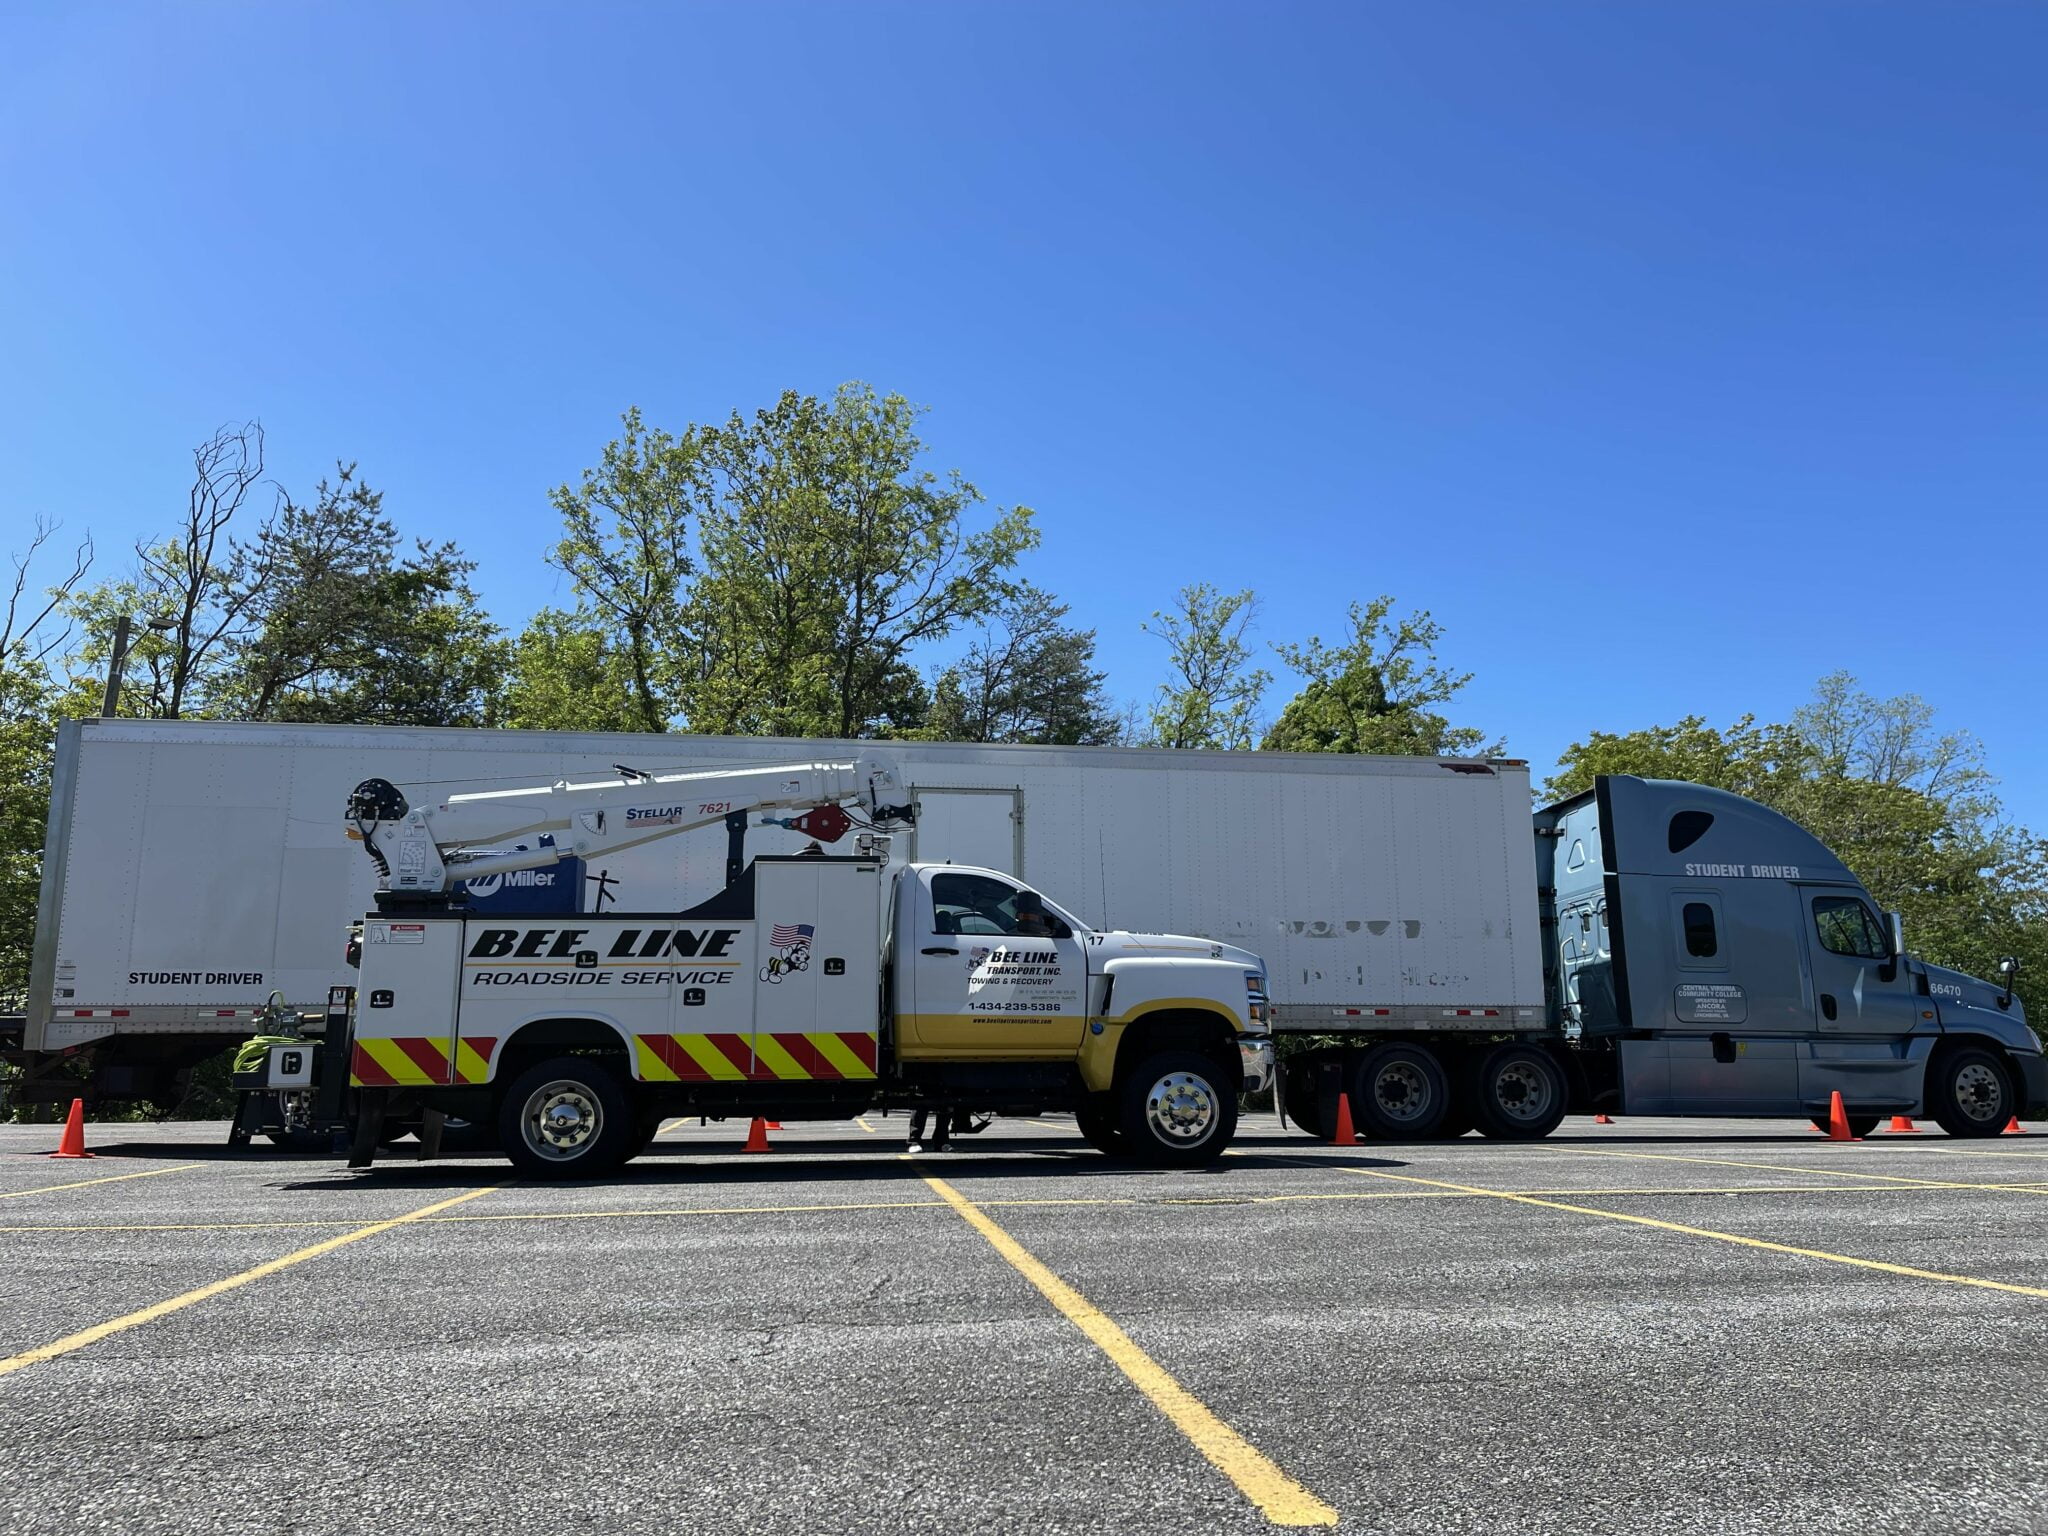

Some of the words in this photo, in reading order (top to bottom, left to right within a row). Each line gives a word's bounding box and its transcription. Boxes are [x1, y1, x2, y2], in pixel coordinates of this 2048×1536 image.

[626, 806, 683, 820] STELLAR
[698, 802, 731, 814] 7621
[1686, 863, 1745, 877] STUDENT
[1751, 865, 1800, 879] DRIVER
[505, 870, 555, 886] Miller
[467, 929, 589, 958] BEE
[607, 929, 741, 958] LINE
[1088, 936, 1104, 945] 17
[991, 952, 1021, 963] BEE
[1023, 952, 1058, 963] LINE
[473, 972, 613, 985] ROADSIDE
[621, 971, 735, 985] SERVICE
[1043, 967, 1062, 976] INC.
[129, 972, 202, 985] STUDENT
[205, 973, 263, 985] DRIVER
[967, 977, 1000, 985] TOWING
[1930, 983, 1961, 996] 66470
[968, 1002, 1061, 1011] 1-434-239-5386
